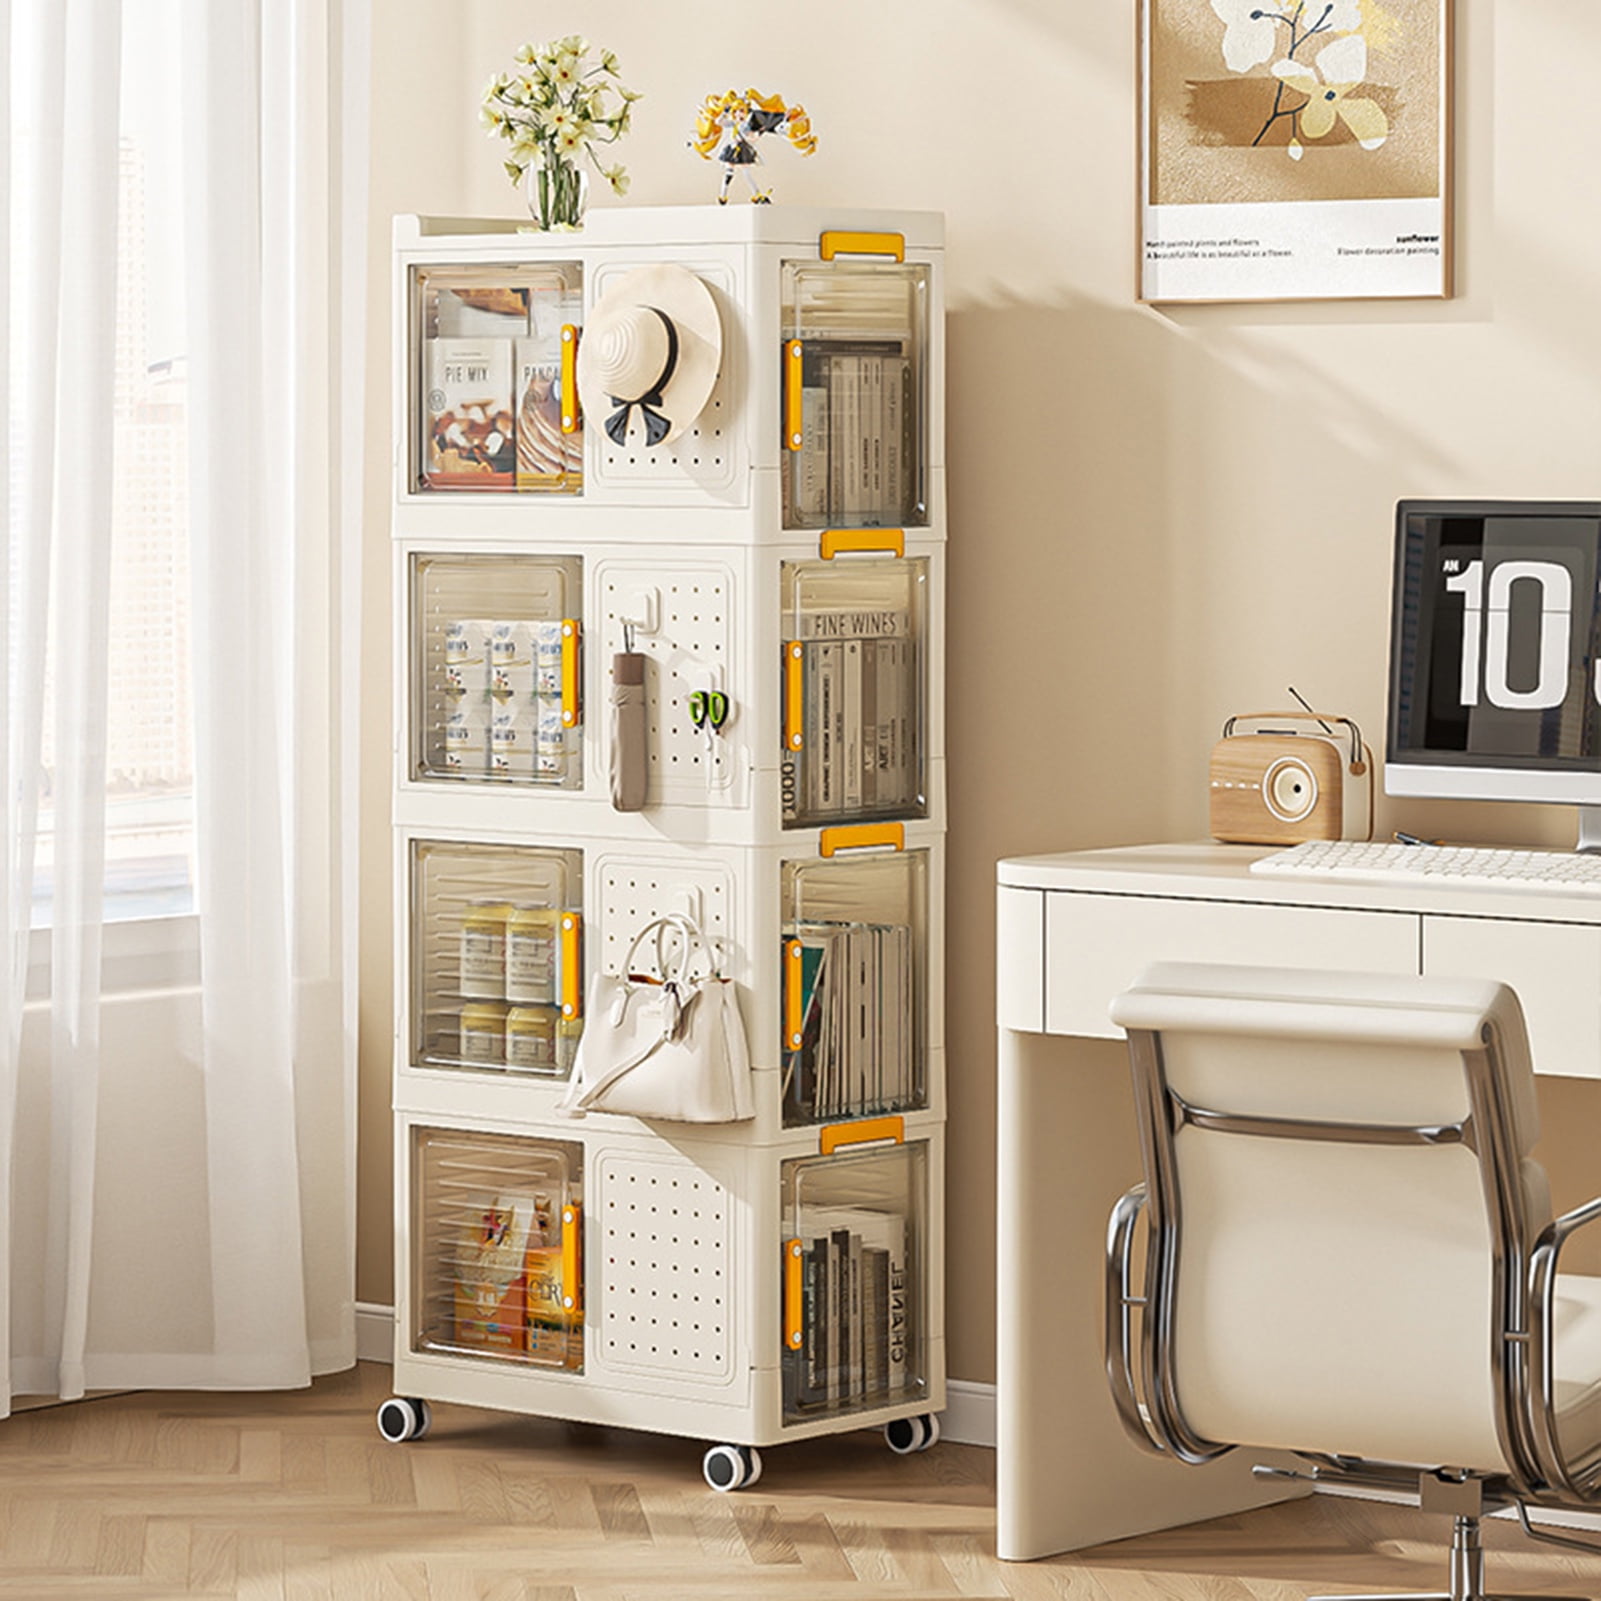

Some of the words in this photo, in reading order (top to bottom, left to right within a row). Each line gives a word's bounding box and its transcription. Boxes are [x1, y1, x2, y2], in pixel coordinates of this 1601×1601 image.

[445, 366, 462, 382] PIE
[468, 366, 488, 381] MIX
[816, 614, 845, 636] FINE
[850, 612, 897, 635] WINES
[1446, 560, 1572, 710] 10
